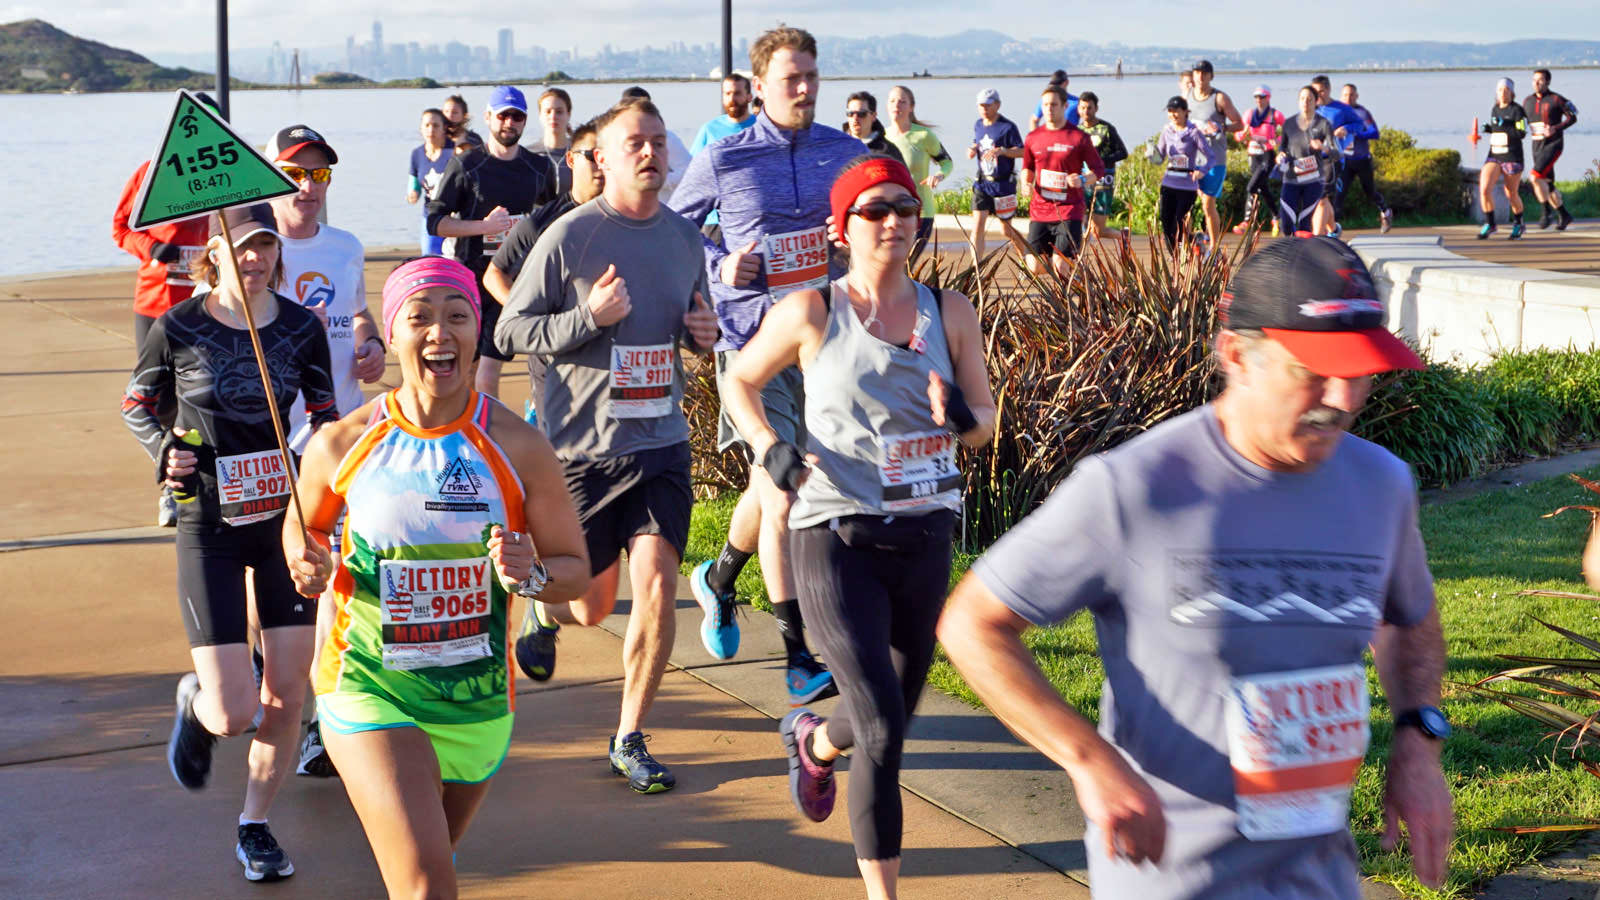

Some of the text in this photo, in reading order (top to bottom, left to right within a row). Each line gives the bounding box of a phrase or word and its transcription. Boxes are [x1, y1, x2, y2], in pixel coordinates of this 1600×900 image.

[166, 141, 239, 177] 1:55
[188, 173, 231, 194] (8:47)
[167, 186, 262, 214] Trivalleyrunning.org
[646, 368, 671, 384] 9111
[256, 475, 290, 497] 907
[431, 591, 488, 619] 9065
[394, 618, 481, 643] MARY ANN
